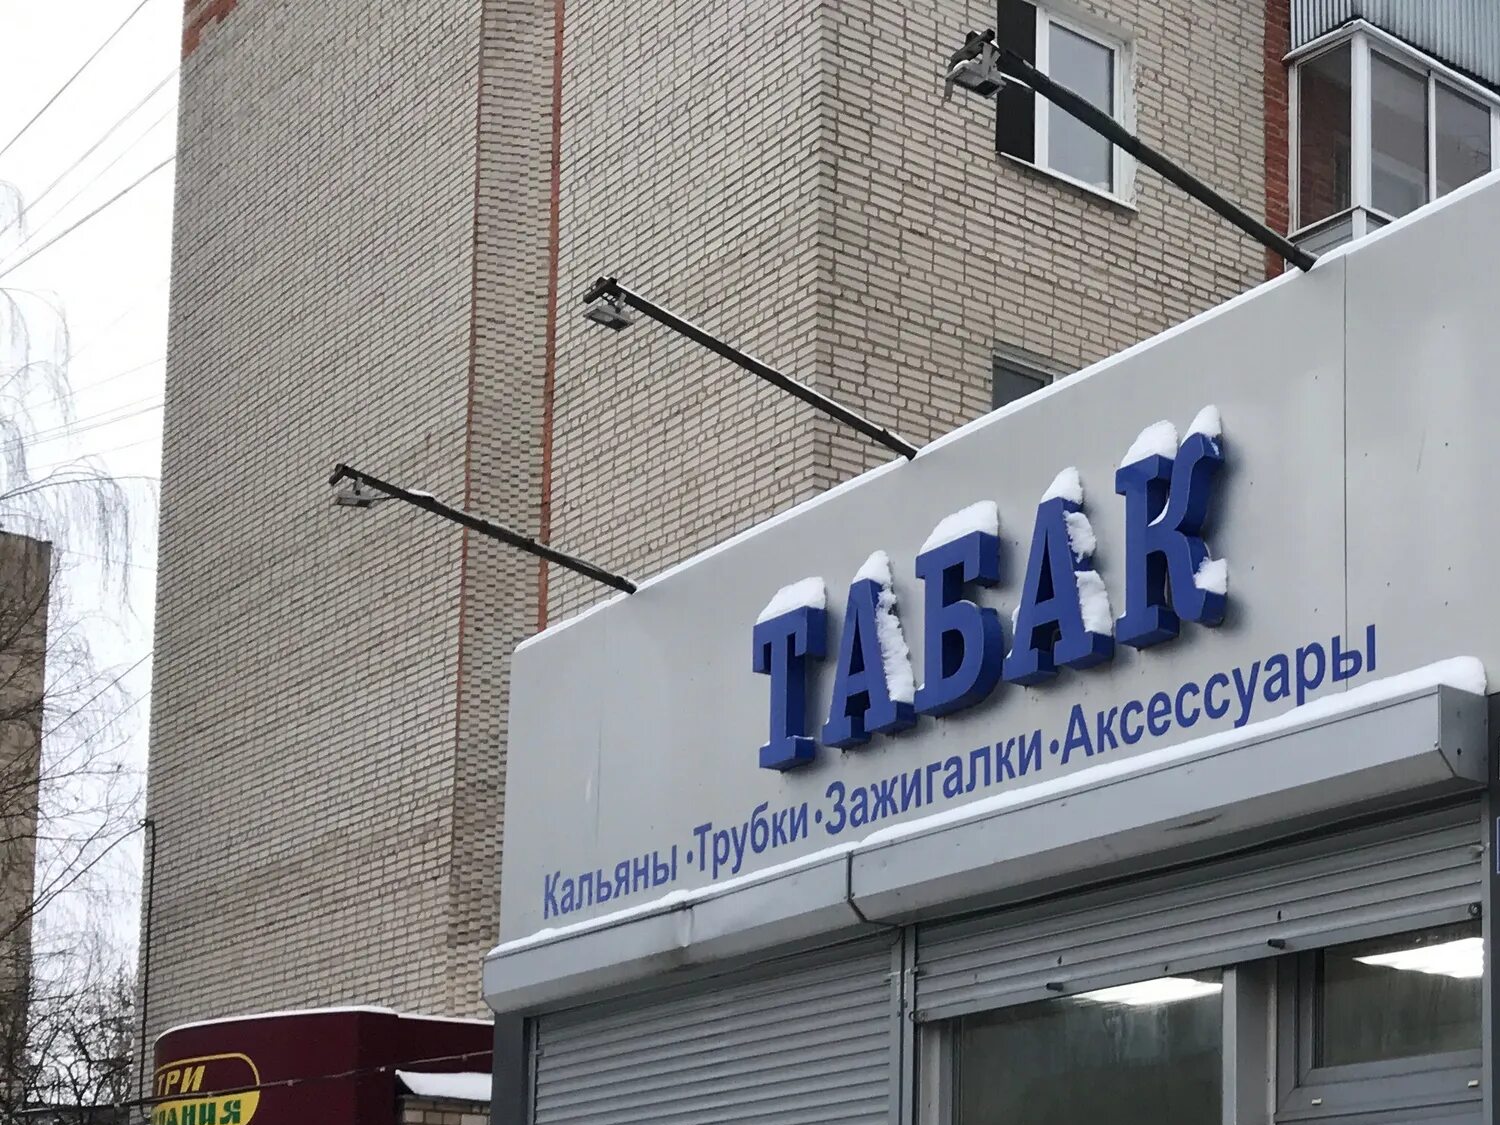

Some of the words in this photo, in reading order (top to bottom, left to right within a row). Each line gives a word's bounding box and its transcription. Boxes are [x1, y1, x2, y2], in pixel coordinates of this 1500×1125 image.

[752, 430, 1227, 769] ТАБАК
[543, 846, 679, 919] Кальяны
[693, 801, 810, 880] Трубки
[824, 729, 1044, 836] Зажигалки
[1061, 624, 1377, 763] Аксессуары
